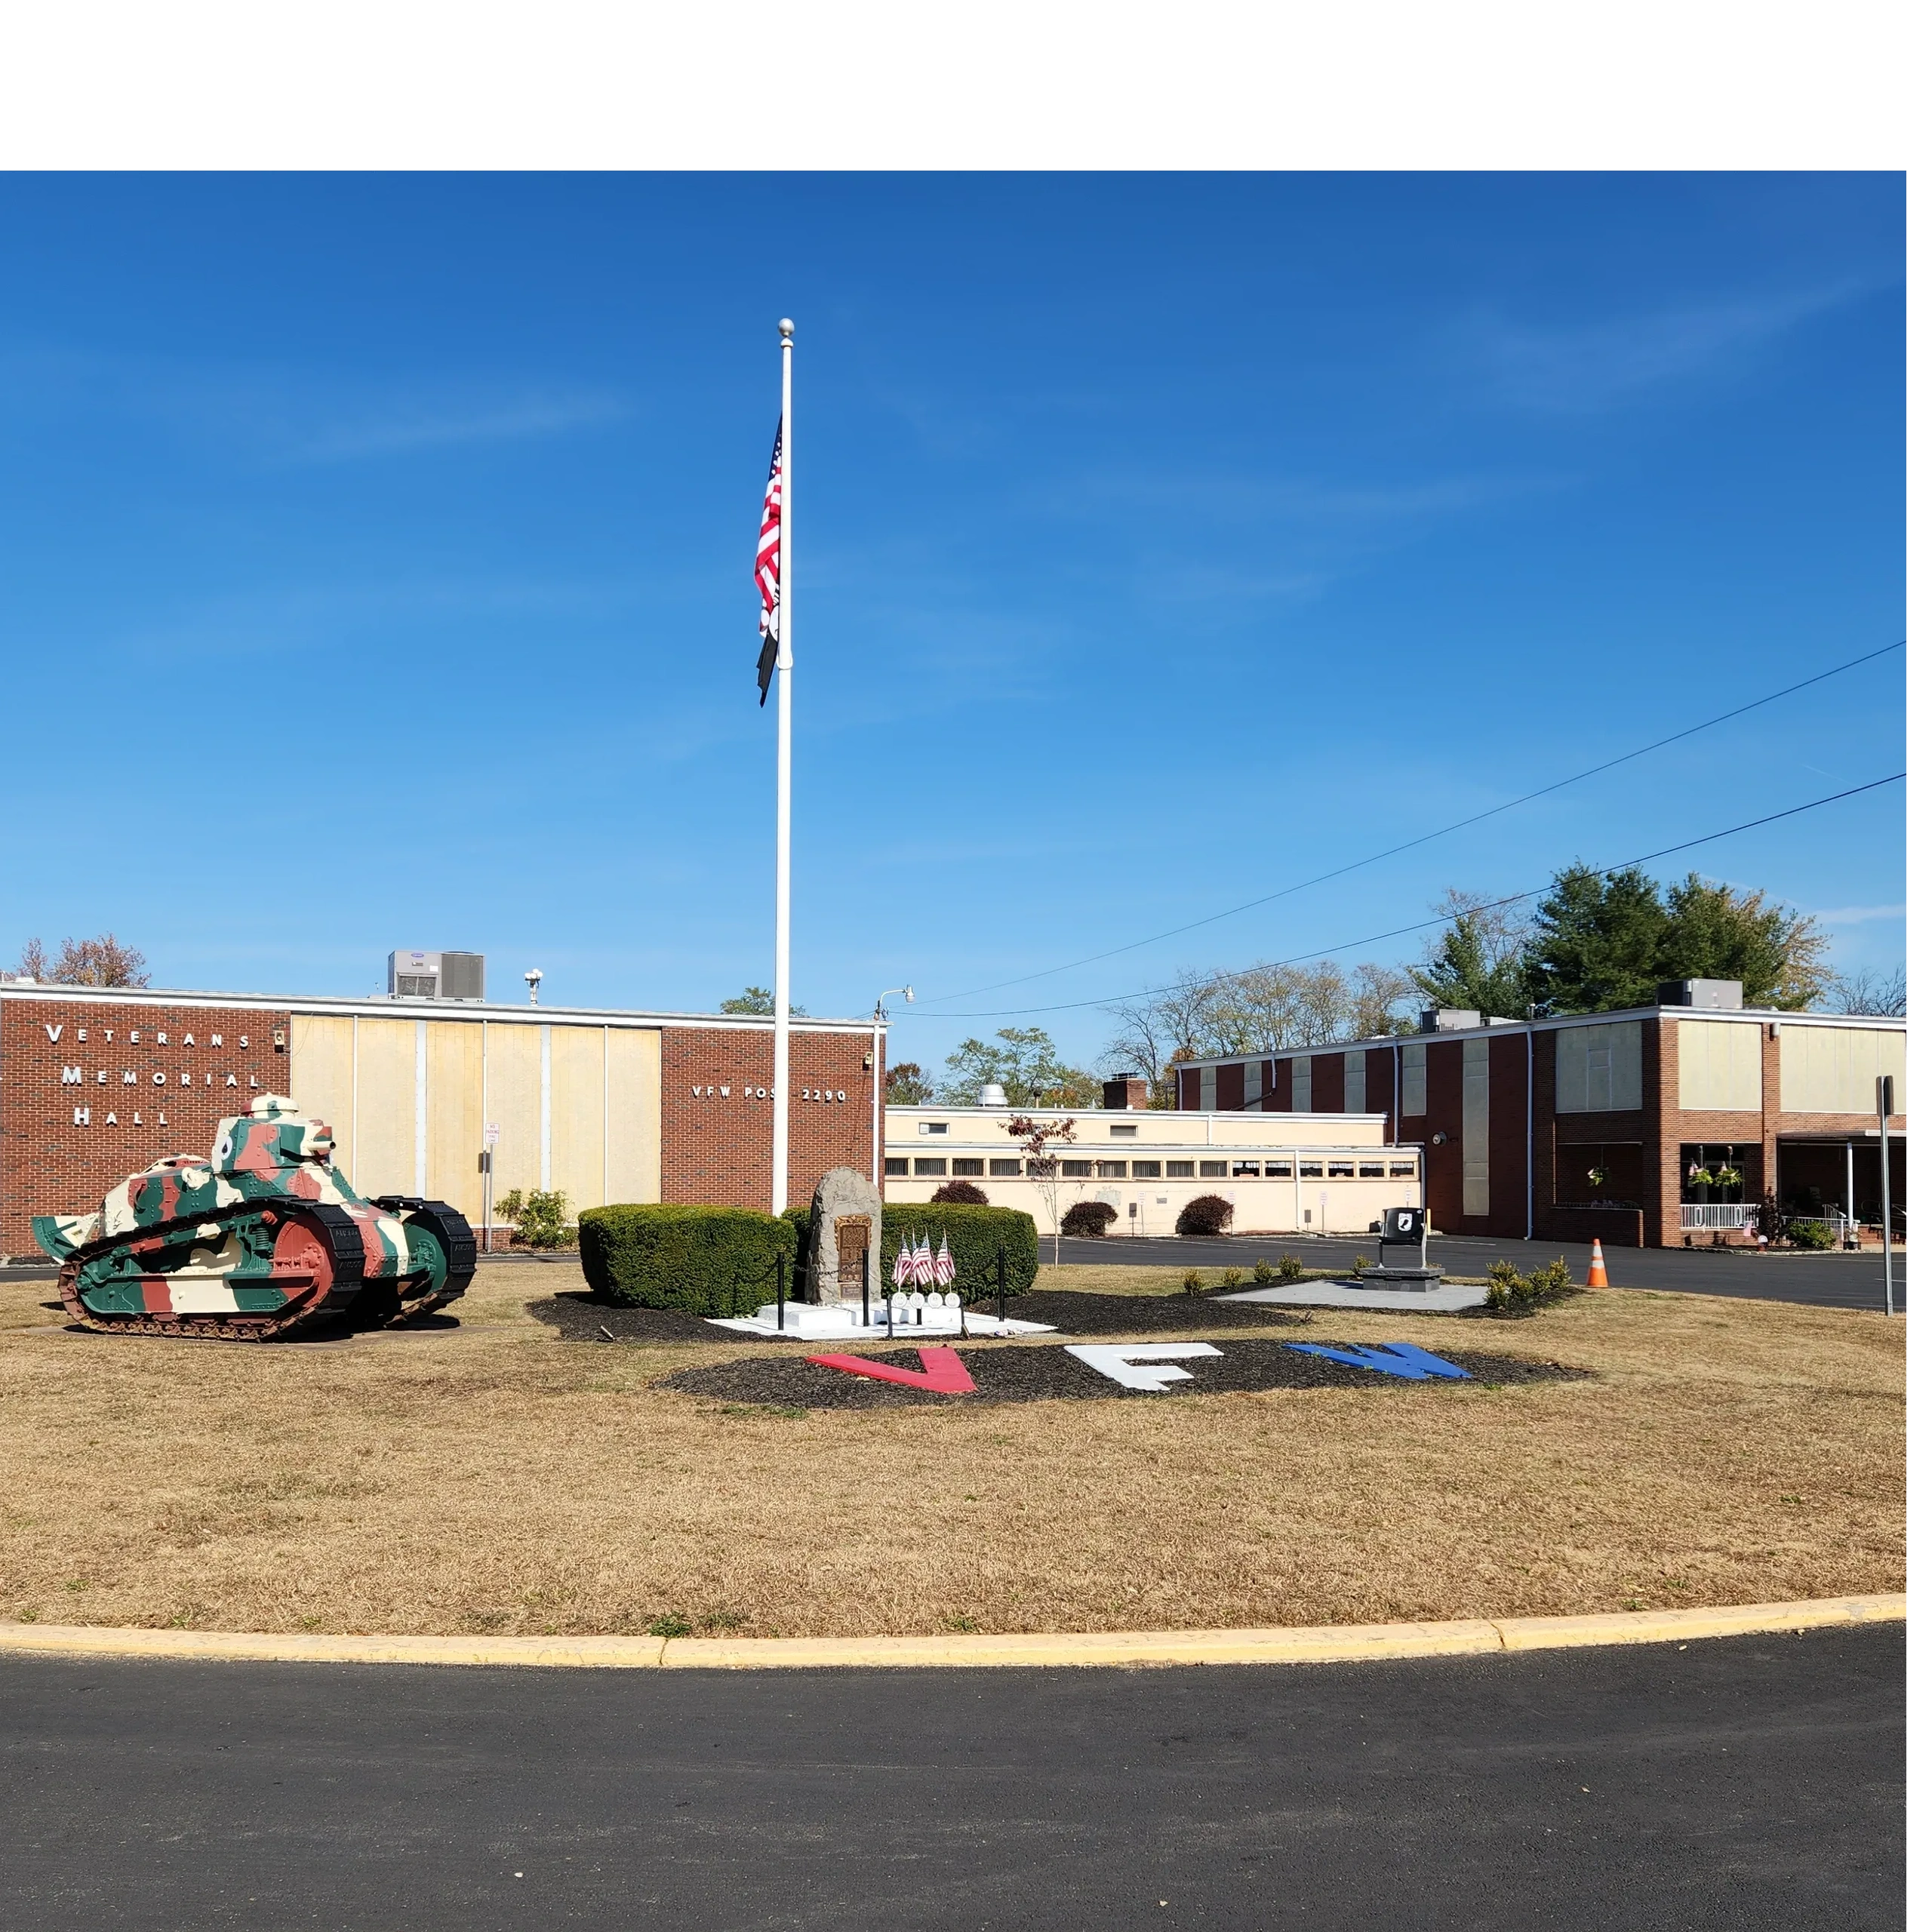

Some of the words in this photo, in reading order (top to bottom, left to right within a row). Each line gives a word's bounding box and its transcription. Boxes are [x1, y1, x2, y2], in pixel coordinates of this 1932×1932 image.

[45, 1024, 249, 1049] VETERANS
[62, 1066, 258, 1088] MEMORIAL
[692, 1086, 730, 1098] VFW
[744, 1087, 774, 1100] POS
[802, 1089, 846, 1102] 2290
[74, 1106, 168, 1126] HALL
